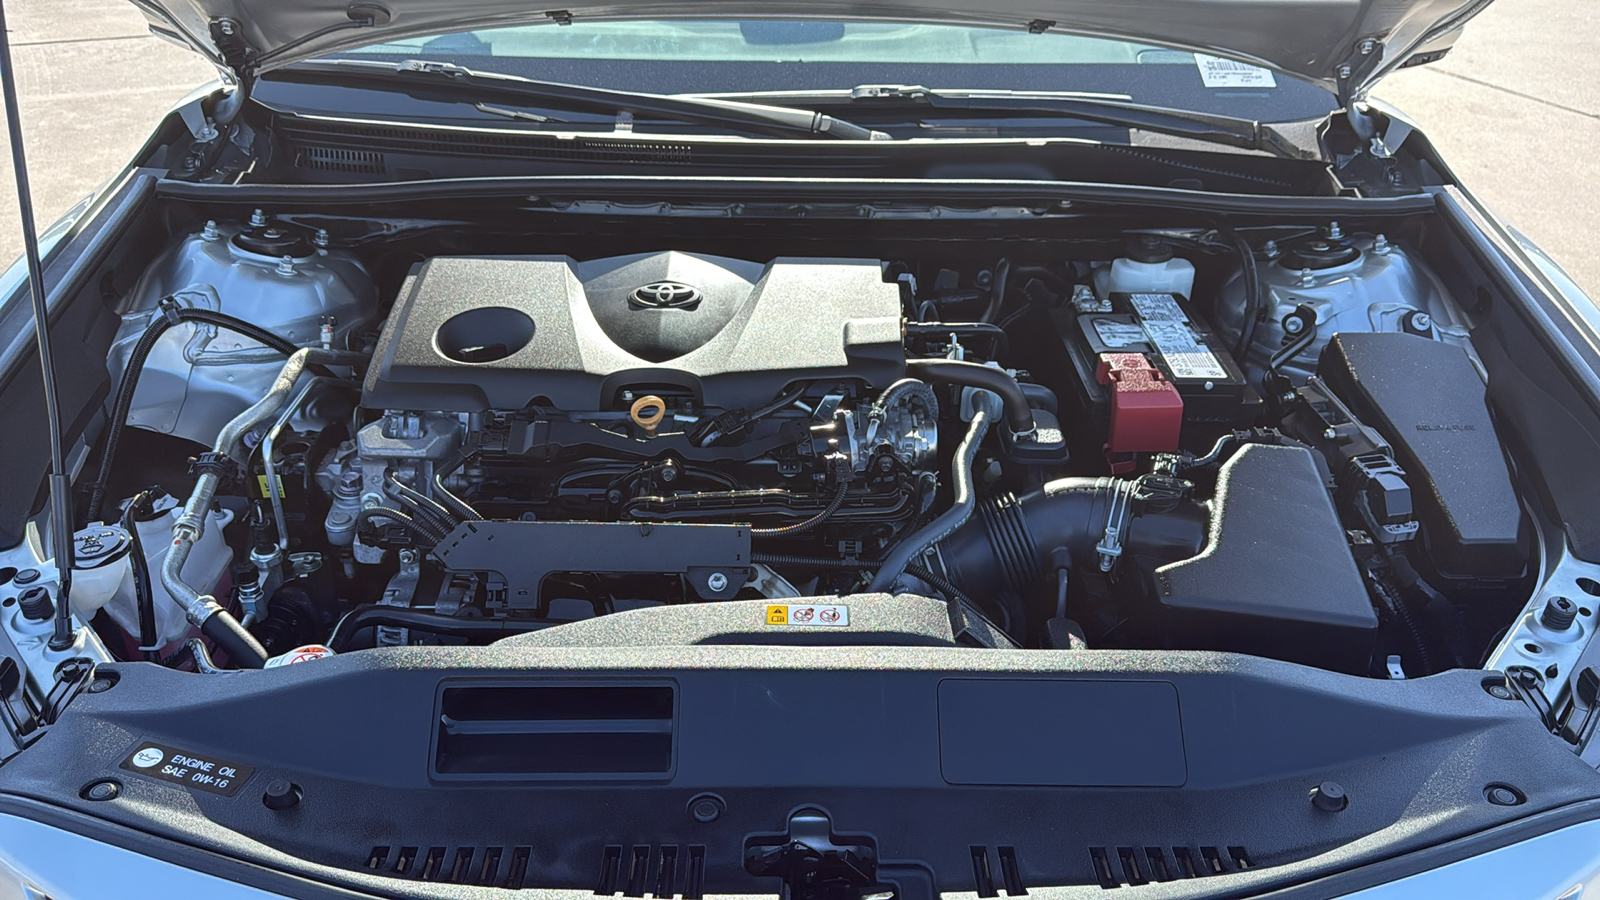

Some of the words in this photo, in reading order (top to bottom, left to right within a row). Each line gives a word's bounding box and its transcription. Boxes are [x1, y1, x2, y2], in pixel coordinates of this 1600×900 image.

[161, 765, 188, 778] SAE
[192, 773, 229, 788] 0W-16
[171, 754, 215, 772] ENGINE
[218, 766, 236, 778] OIL
